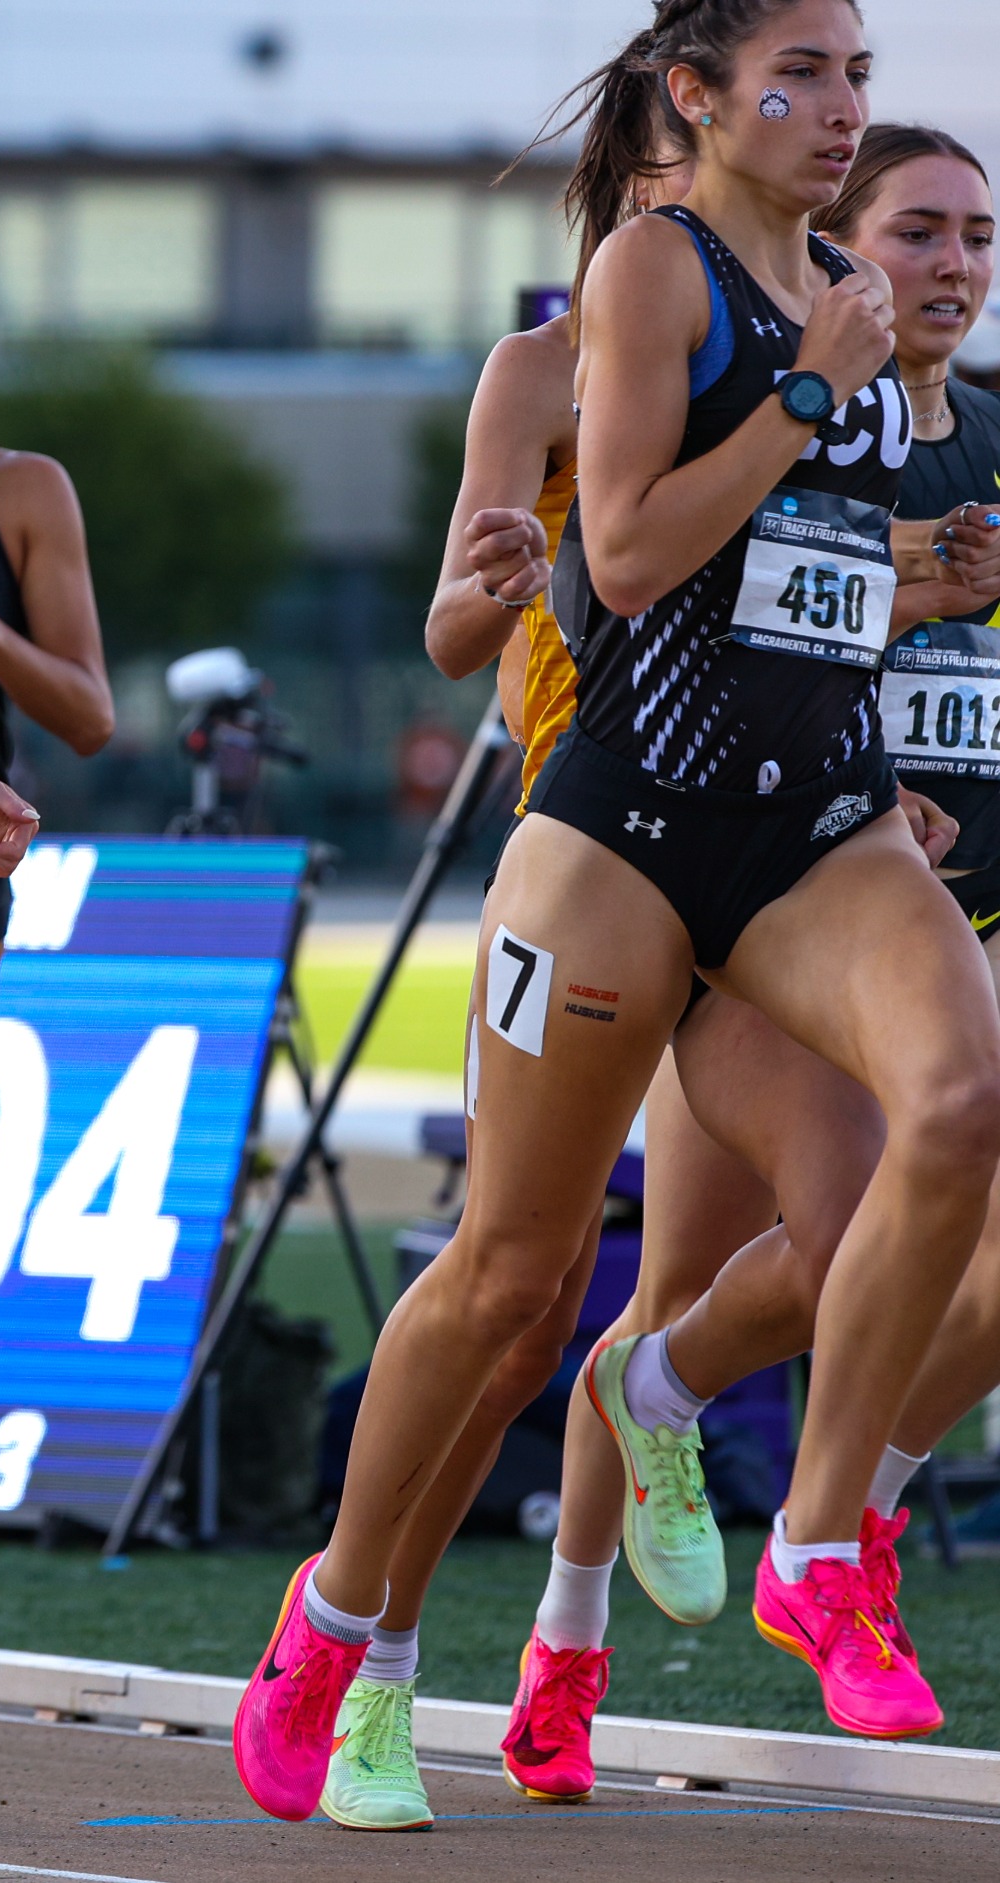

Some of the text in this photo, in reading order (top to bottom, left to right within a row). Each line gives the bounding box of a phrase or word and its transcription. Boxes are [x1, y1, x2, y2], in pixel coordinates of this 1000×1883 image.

[774, 370, 912, 469] CU
[780, 521, 807, 537] TRACK
[815, 527, 837, 542] FIELD
[776, 565, 867, 634] 450
[750, 632, 811, 655] SACRAMENTO,
[813, 643, 825, 656] CA
[840, 647, 859, 662] MAY
[915, 652, 941, 665] TRACK
[949, 655, 968, 667] FIELD
[893, 758, 955, 774] SACRAMENTO,
[957, 762, 968, 774] CA
[979, 764, 995, 776] MAY
[499, 936, 537, 1033] 7
[567, 983, 620, 1003] HUSKIES
[564, 1002, 617, 1022] HUSKIES
